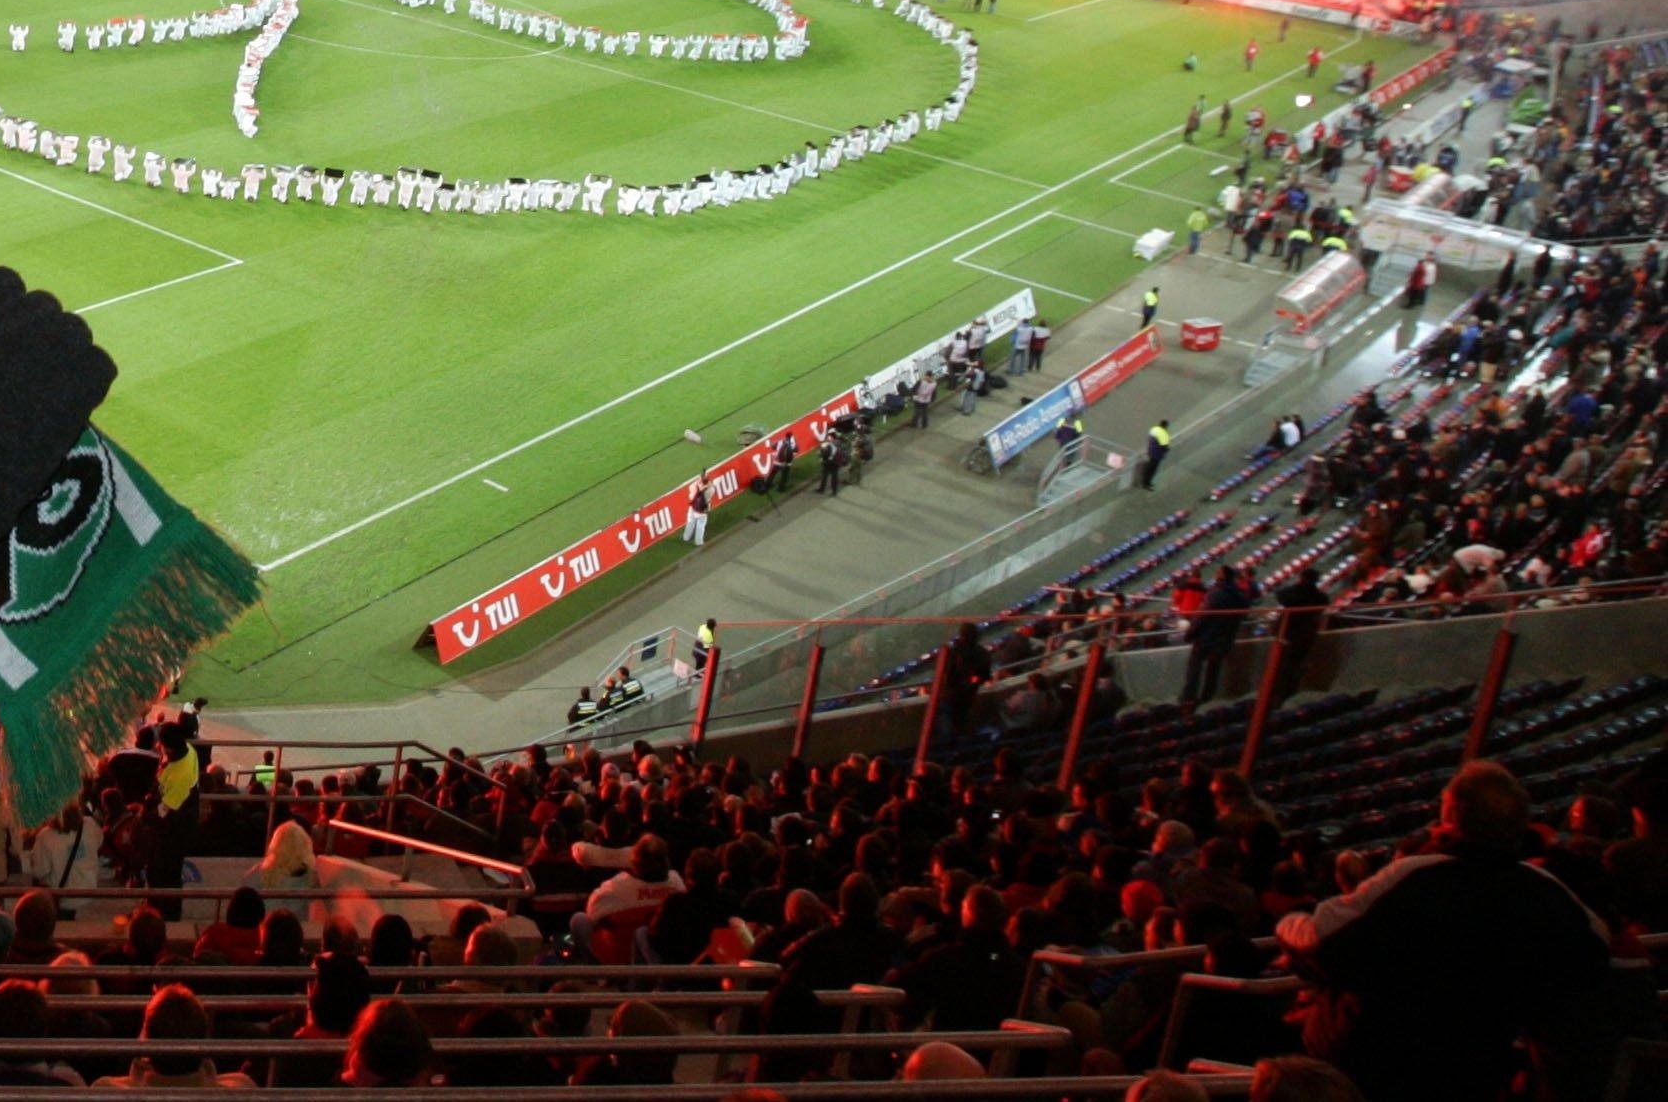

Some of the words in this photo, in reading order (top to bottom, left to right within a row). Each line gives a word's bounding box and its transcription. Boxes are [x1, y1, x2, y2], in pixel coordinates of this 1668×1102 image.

[485, 594, 519, 631] TUI
[569, 548, 601, 582] TUI
[644, 507, 673, 539] TUI
[713, 469, 739, 500] TUI
